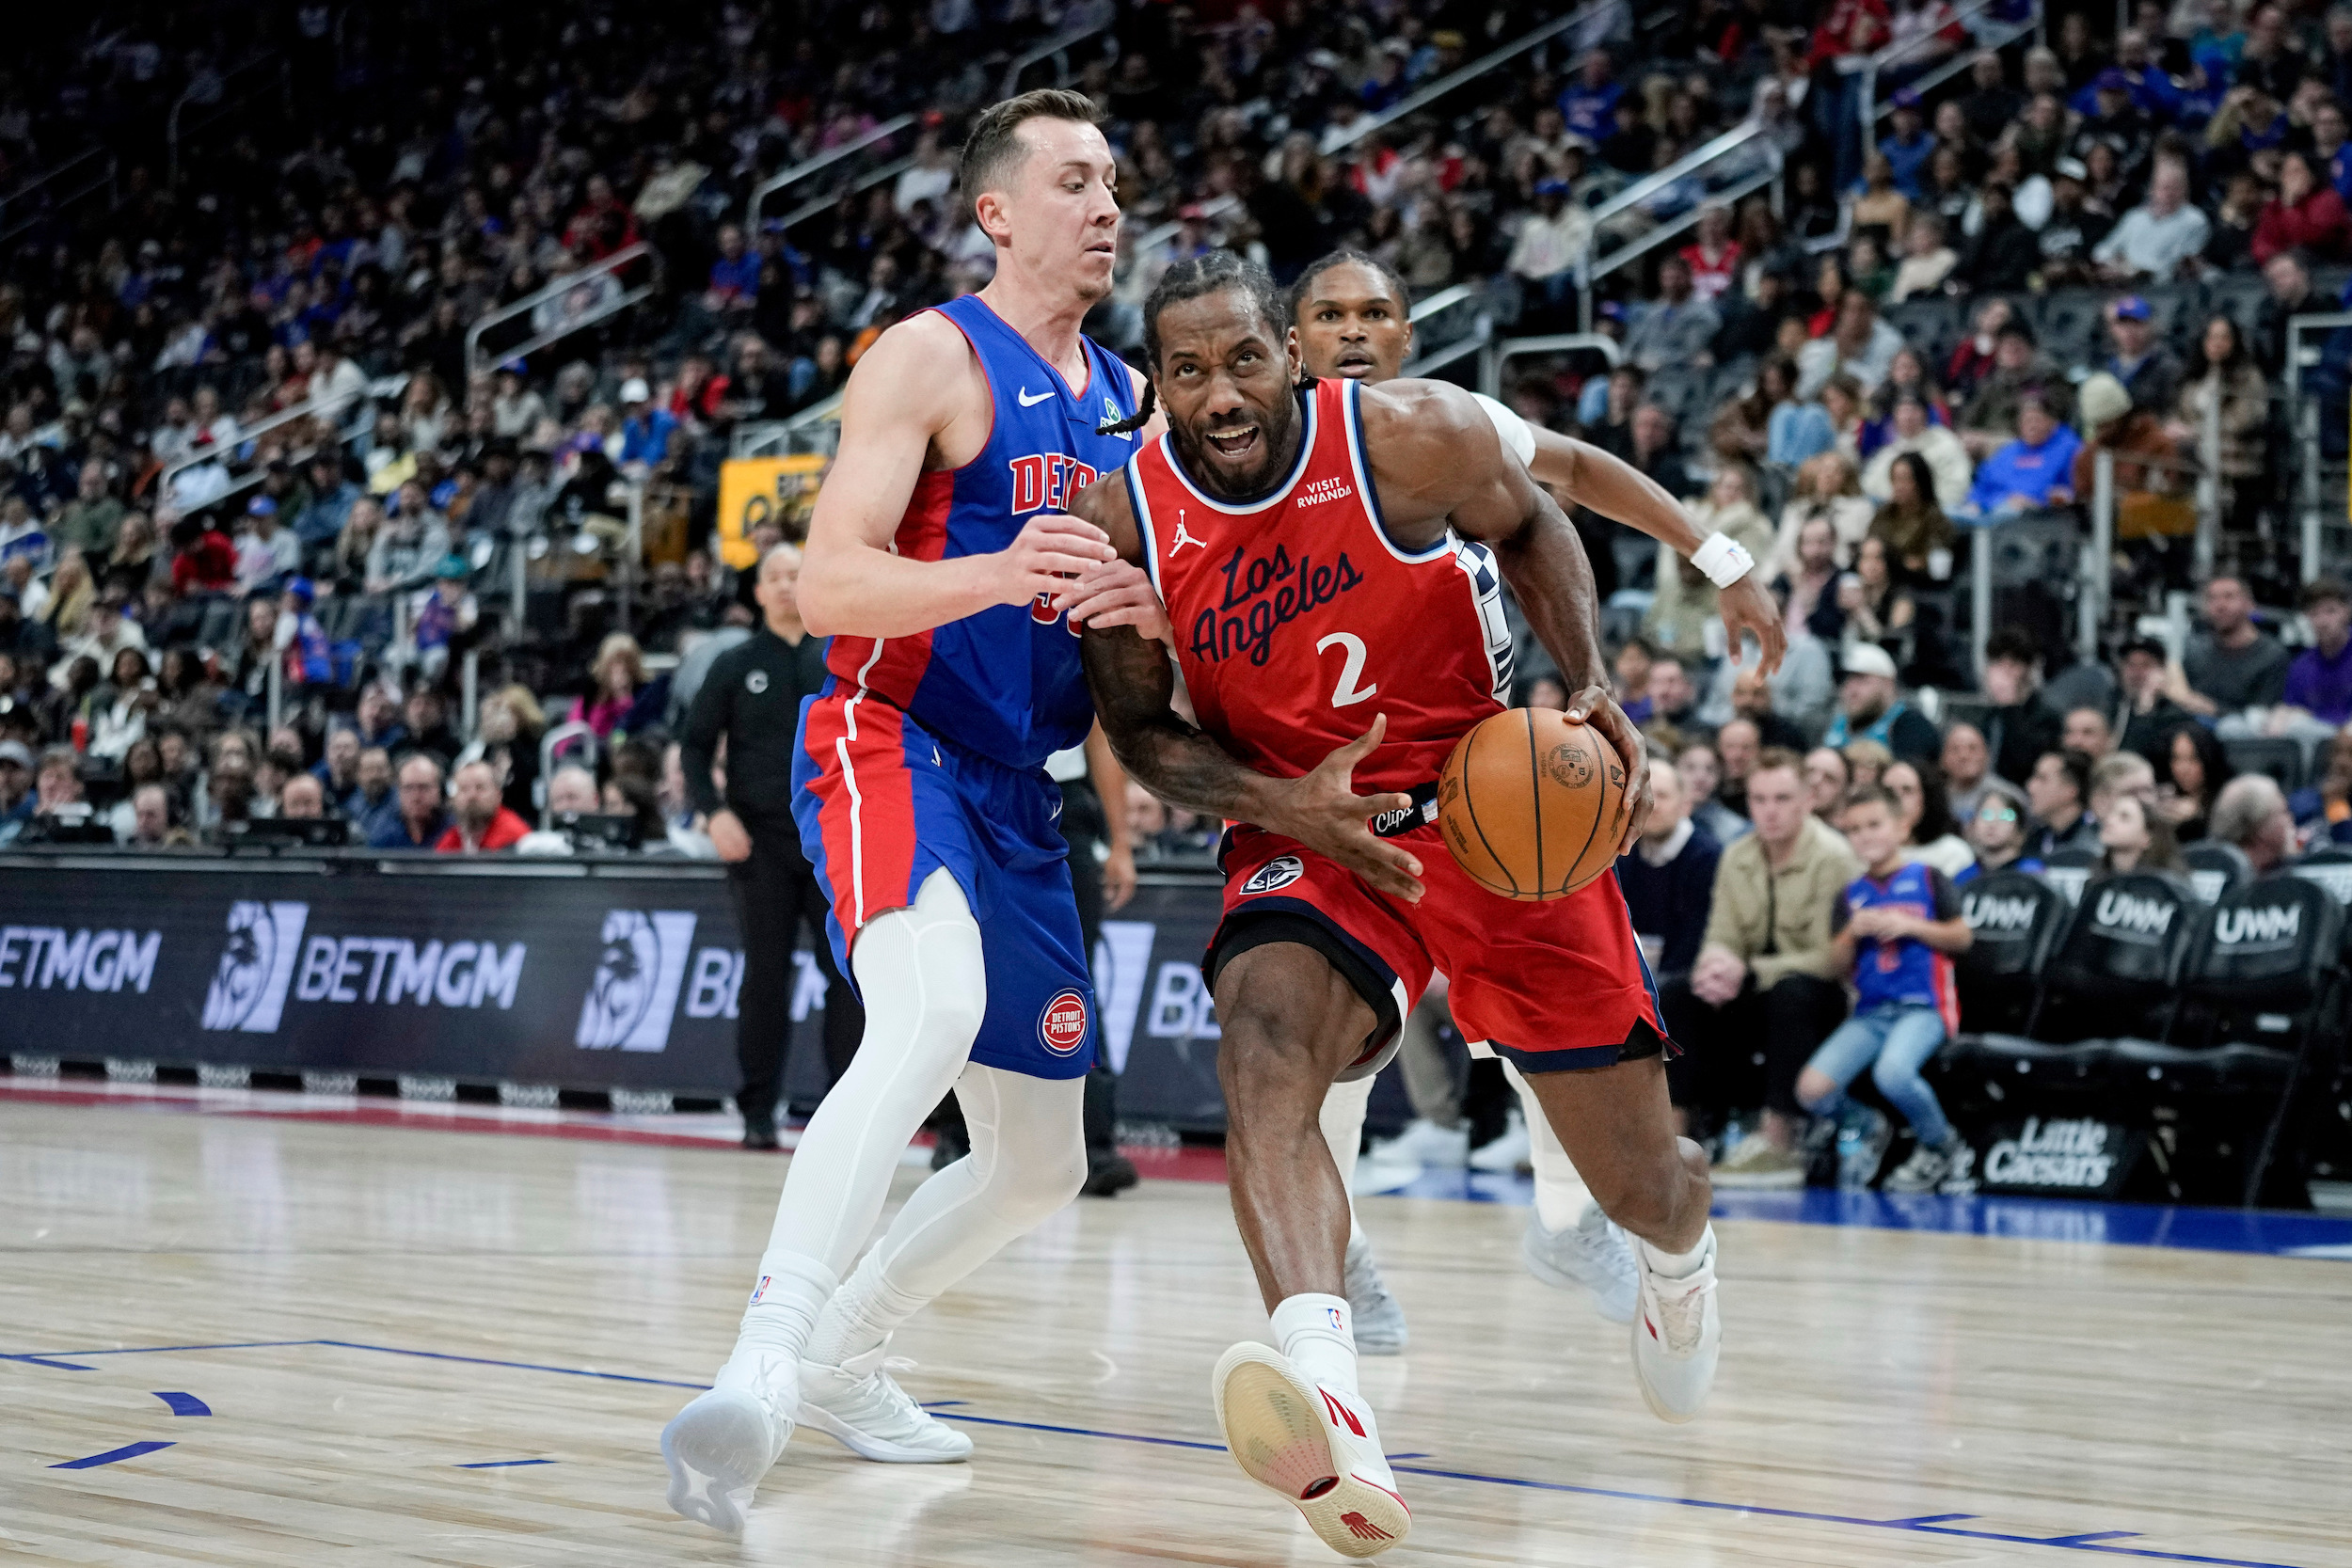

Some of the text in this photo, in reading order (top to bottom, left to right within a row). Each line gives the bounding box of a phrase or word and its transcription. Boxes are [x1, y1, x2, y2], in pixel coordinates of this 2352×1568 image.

[1296, 484, 1353, 509] RWANDA
[1306, 476, 1341, 494] VISIT
[1220, 544, 1295, 612] Los
[1190, 552, 1364, 667] Angeles
[1316, 632, 1377, 708] 2
[1375, 807, 1414, 833] Clips
[1962, 892, 2037, 930] UWM
[2096, 889, 2177, 933] UWM
[2216, 902, 2301, 943] UWM
[0, 926, 162, 994] ETMGM
[296, 936, 527, 1010] BETMGM
[1050, 1021, 1082, 1035] PISTONS
[1052, 1009, 1082, 1023] DETROIT
[2021, 1116, 2107, 1155] Little
[1984, 1140, 2112, 1187] Caesars
